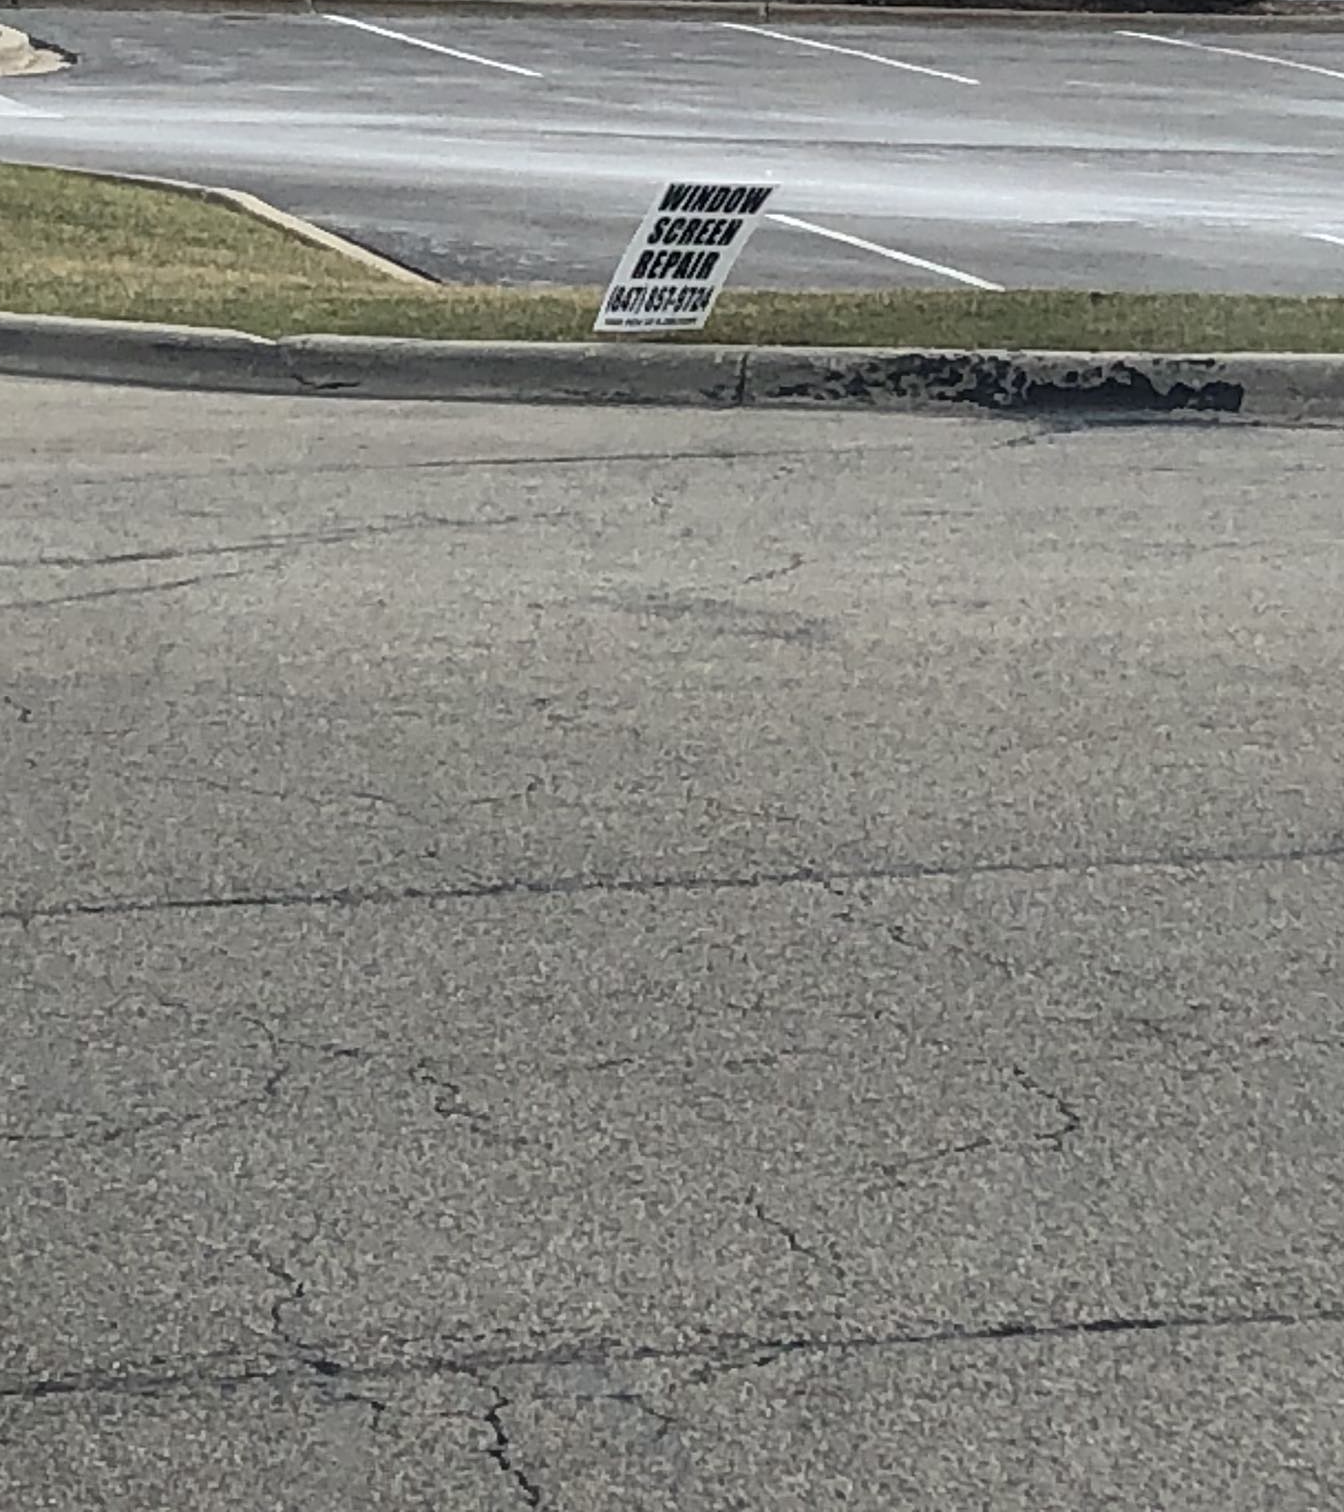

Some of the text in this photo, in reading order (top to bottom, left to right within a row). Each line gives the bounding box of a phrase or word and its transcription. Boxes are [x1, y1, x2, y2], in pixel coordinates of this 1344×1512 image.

[658, 184, 773, 215] WINDOW
[647, 216, 744, 246] SCREEN
[631, 249, 721, 279] REPAIR
